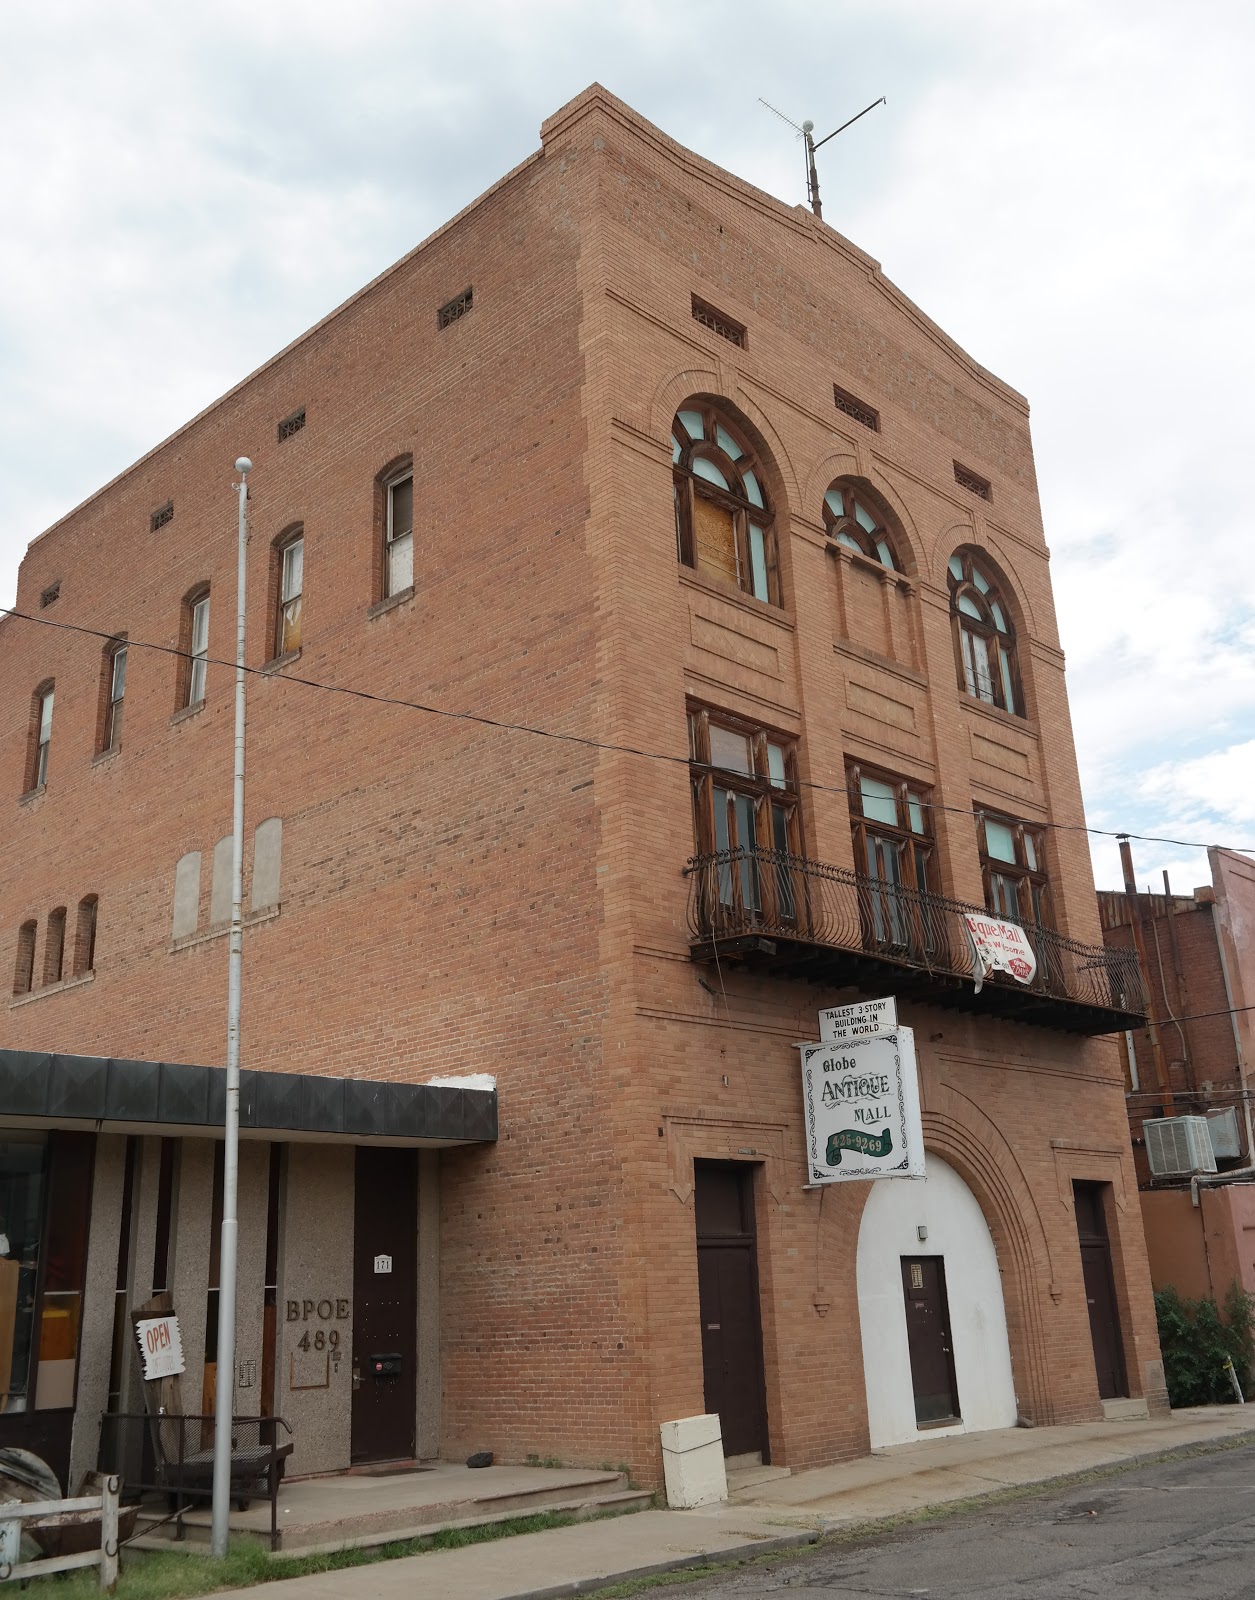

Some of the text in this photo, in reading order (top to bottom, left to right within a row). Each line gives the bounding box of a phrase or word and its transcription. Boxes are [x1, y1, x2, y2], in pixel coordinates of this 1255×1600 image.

[997, 924, 1023, 944] Mall
[825, 1008, 854, 1019] TALLEST
[835, 1014, 878, 1028] BUILDING IN
[833, 1024, 879, 1038] THE WORLD
[823, 1057, 856, 1073] Globe
[821, 1075, 890, 1101] ANTIQUE
[854, 1106, 892, 1123] MALL
[833, 1134, 882, 1152] 425-9269
[376, 1260, 390, 1270] 171
[286, 1299, 350, 1322] BPOE
[146, 1321, 171, 1355] OPEN
[298, 1330, 341, 1353] 489
